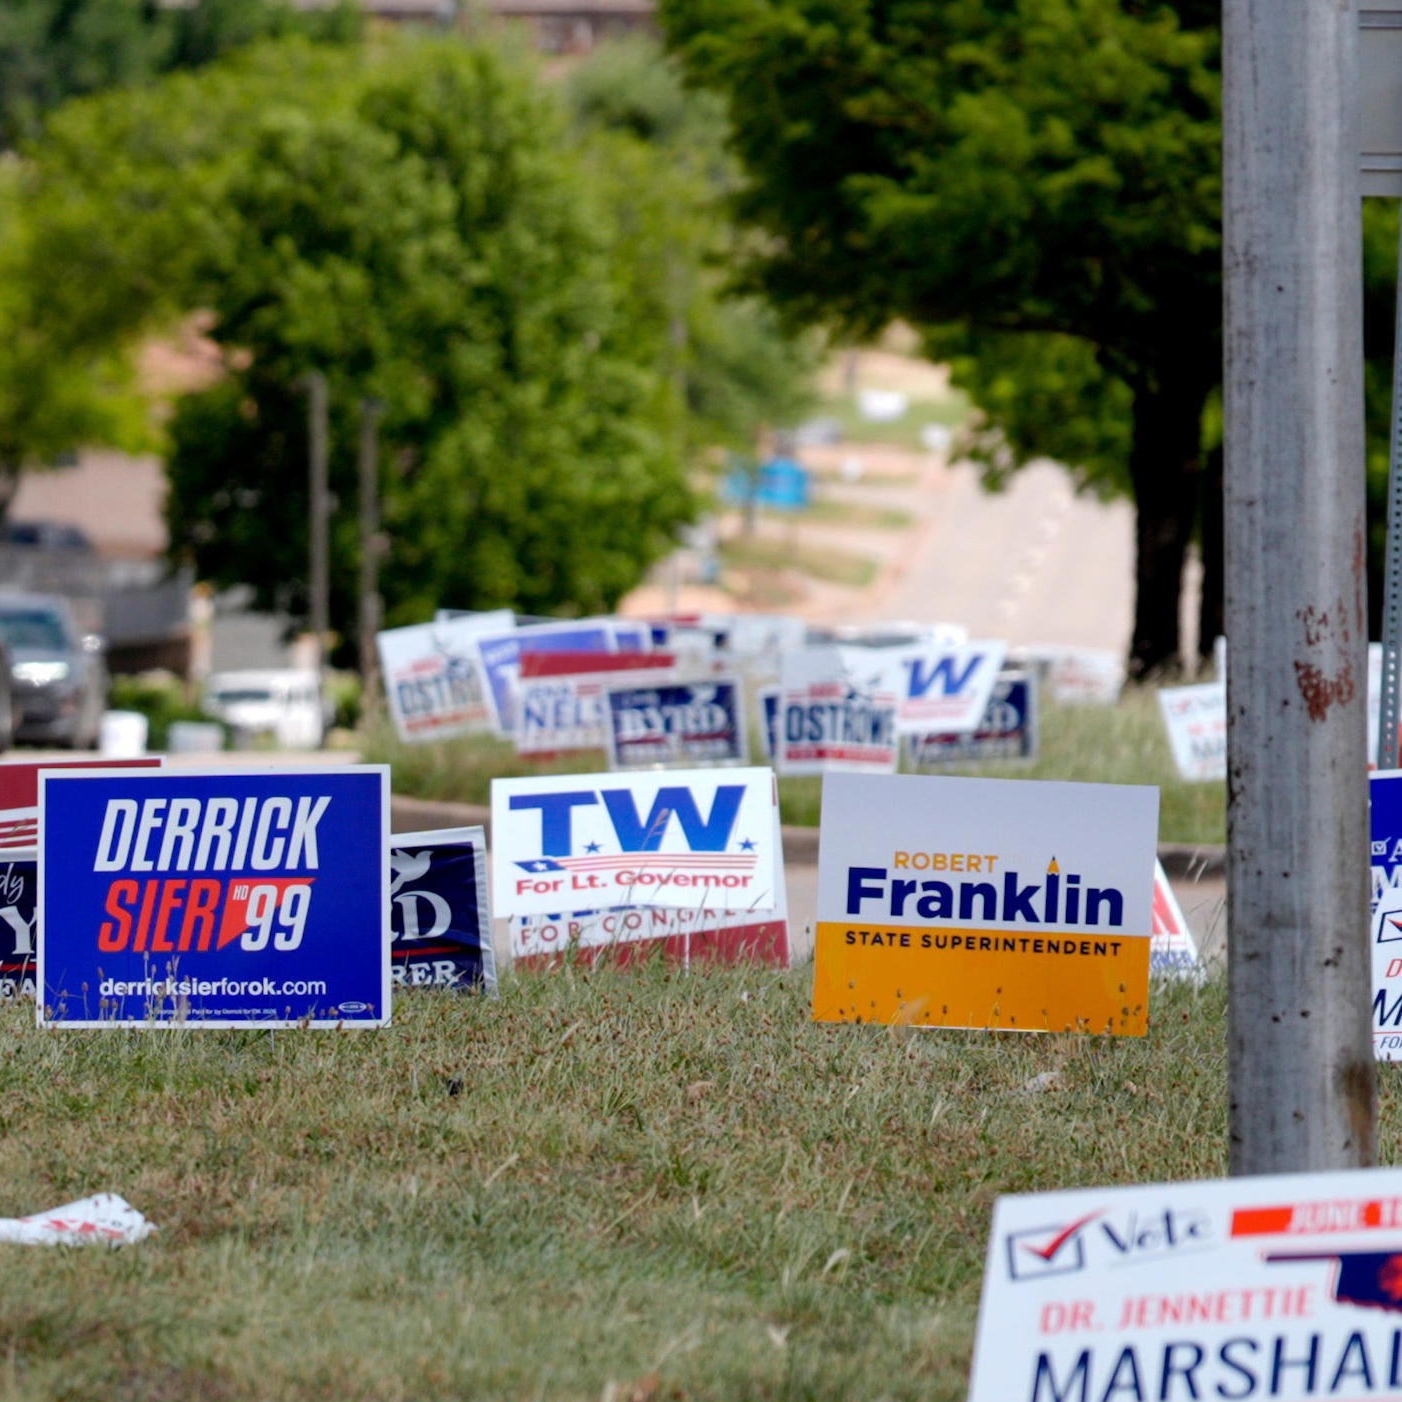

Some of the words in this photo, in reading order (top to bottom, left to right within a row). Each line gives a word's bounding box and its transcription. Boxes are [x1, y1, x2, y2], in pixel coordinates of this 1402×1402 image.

[93, 796, 332, 872] DERRICK
[894, 850, 998, 874] ROBERT
[516, 879, 564, 896] For
[572, 876, 607, 891] Lt.
[614, 870, 753, 890] Governor
[847, 857, 1124, 927] Franklin
[97, 879, 225, 952] SIER
[233, 885, 249, 901] HD
[241, 884, 312, 952] 99
[392, 890, 452, 941] D
[520, 920, 581, 946] FOR
[846, 931, 911, 950] STATE
[921, 934, 1122, 957] SUPERINTENDENT
[99, 977, 327, 996] derricksierforok.com
[1101, 1207, 1212, 1255] Vote
[1041, 1300, 1105, 1336] DR.
